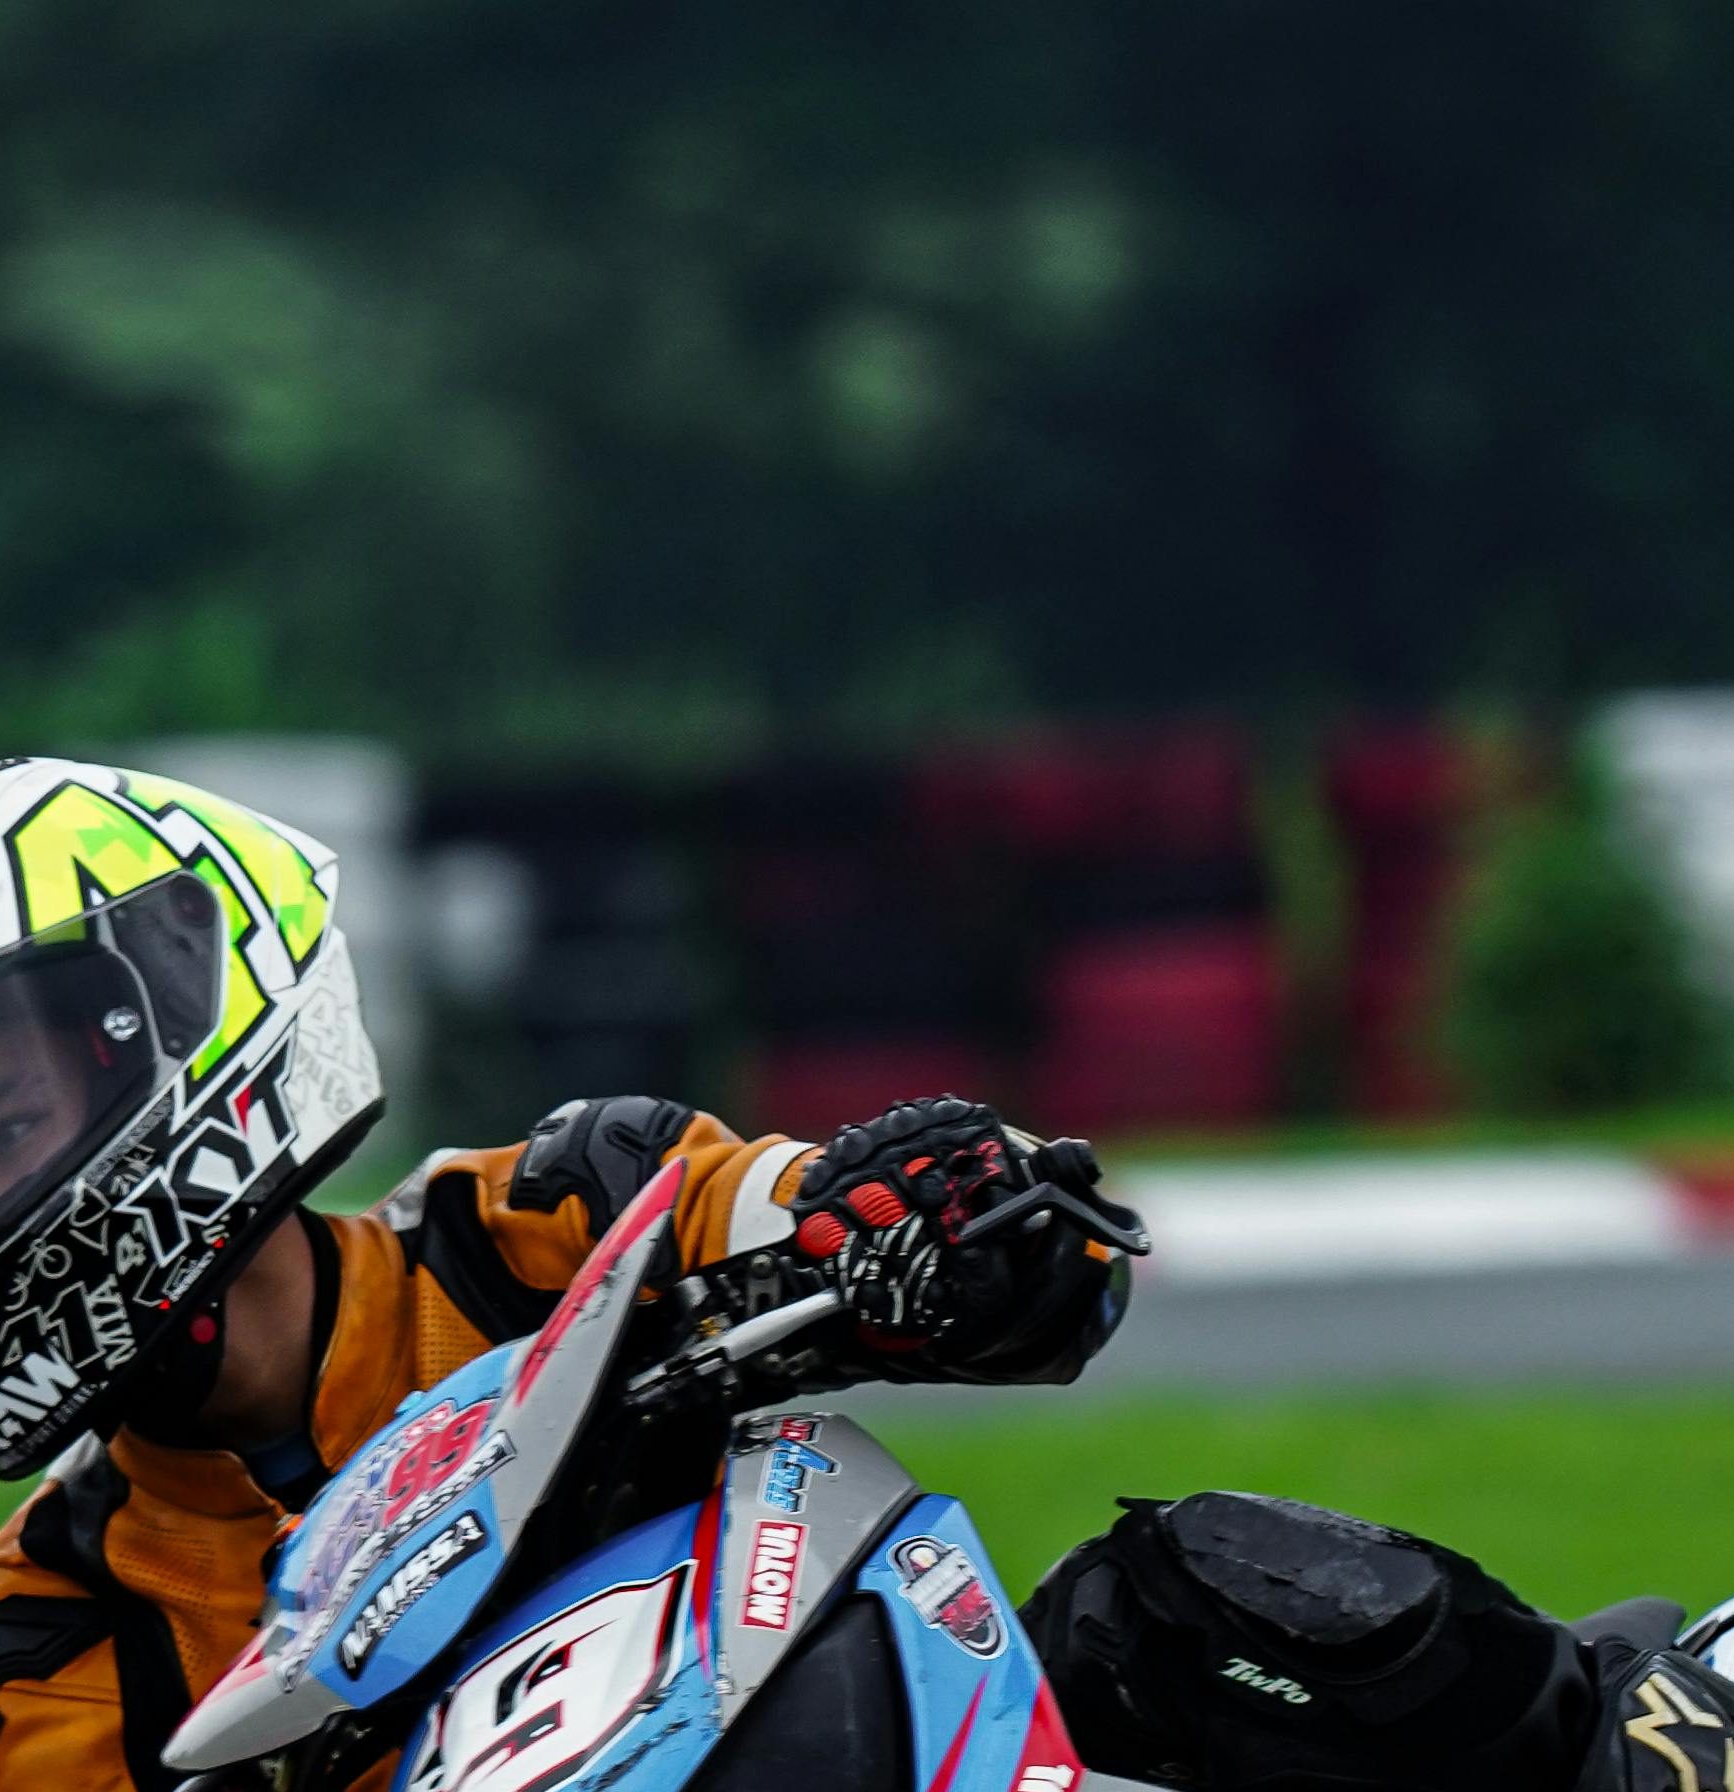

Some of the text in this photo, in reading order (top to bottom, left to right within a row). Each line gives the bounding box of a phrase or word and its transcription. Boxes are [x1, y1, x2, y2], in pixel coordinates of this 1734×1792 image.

[113, 1025, 298, 1267] KYT
[87, 1273, 137, 1371] MIA
[747, 1527, 800, 1626] MOTUL
